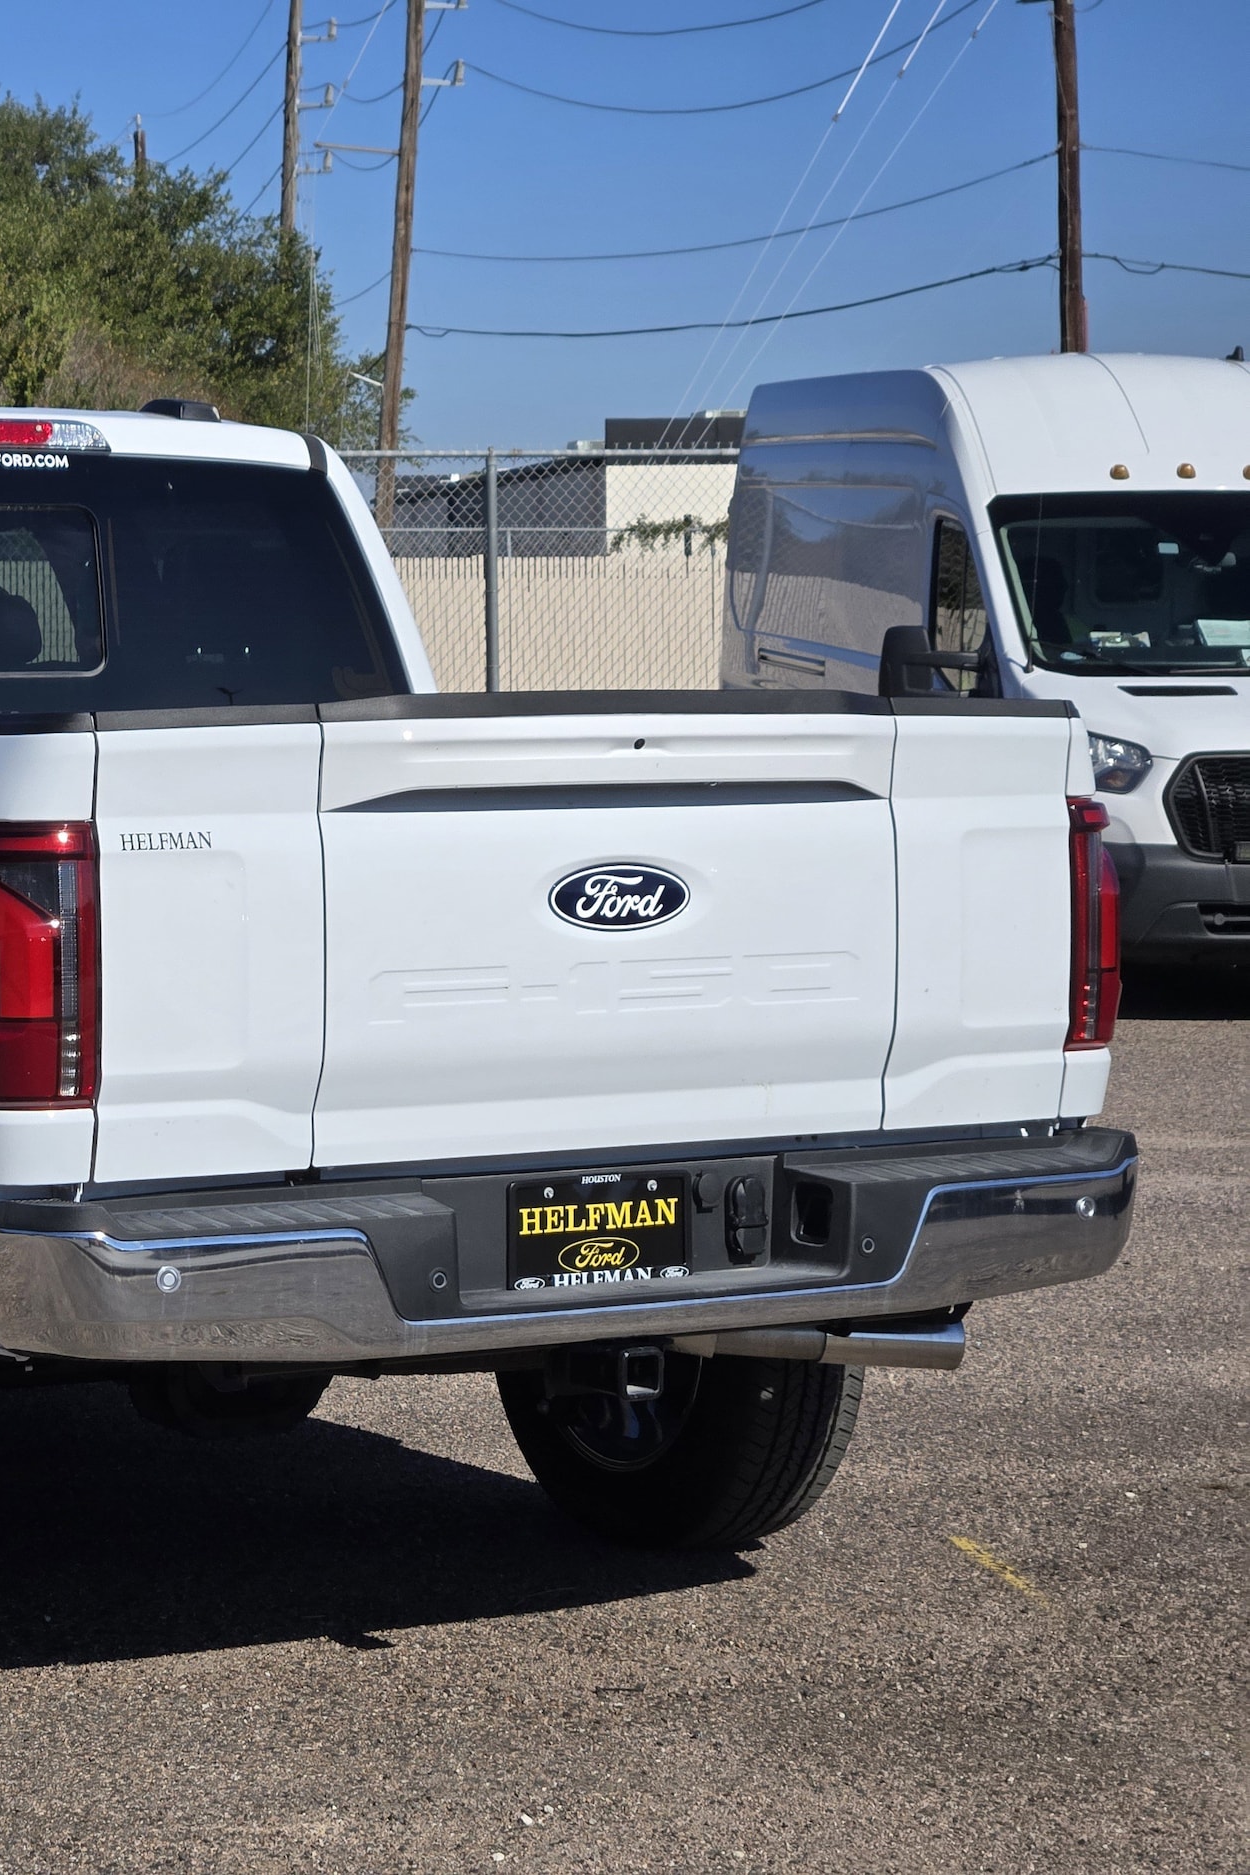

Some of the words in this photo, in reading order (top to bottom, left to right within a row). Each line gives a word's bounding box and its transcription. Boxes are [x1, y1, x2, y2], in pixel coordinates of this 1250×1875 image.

[119, 831, 212, 851] HELFMAN
[575, 873, 665, 920] Ford
[581, 1173, 622, 1185] HOUSTON
[518, 1197, 679, 1236] HELFMAN
[574, 1241, 626, 1269] Ford
